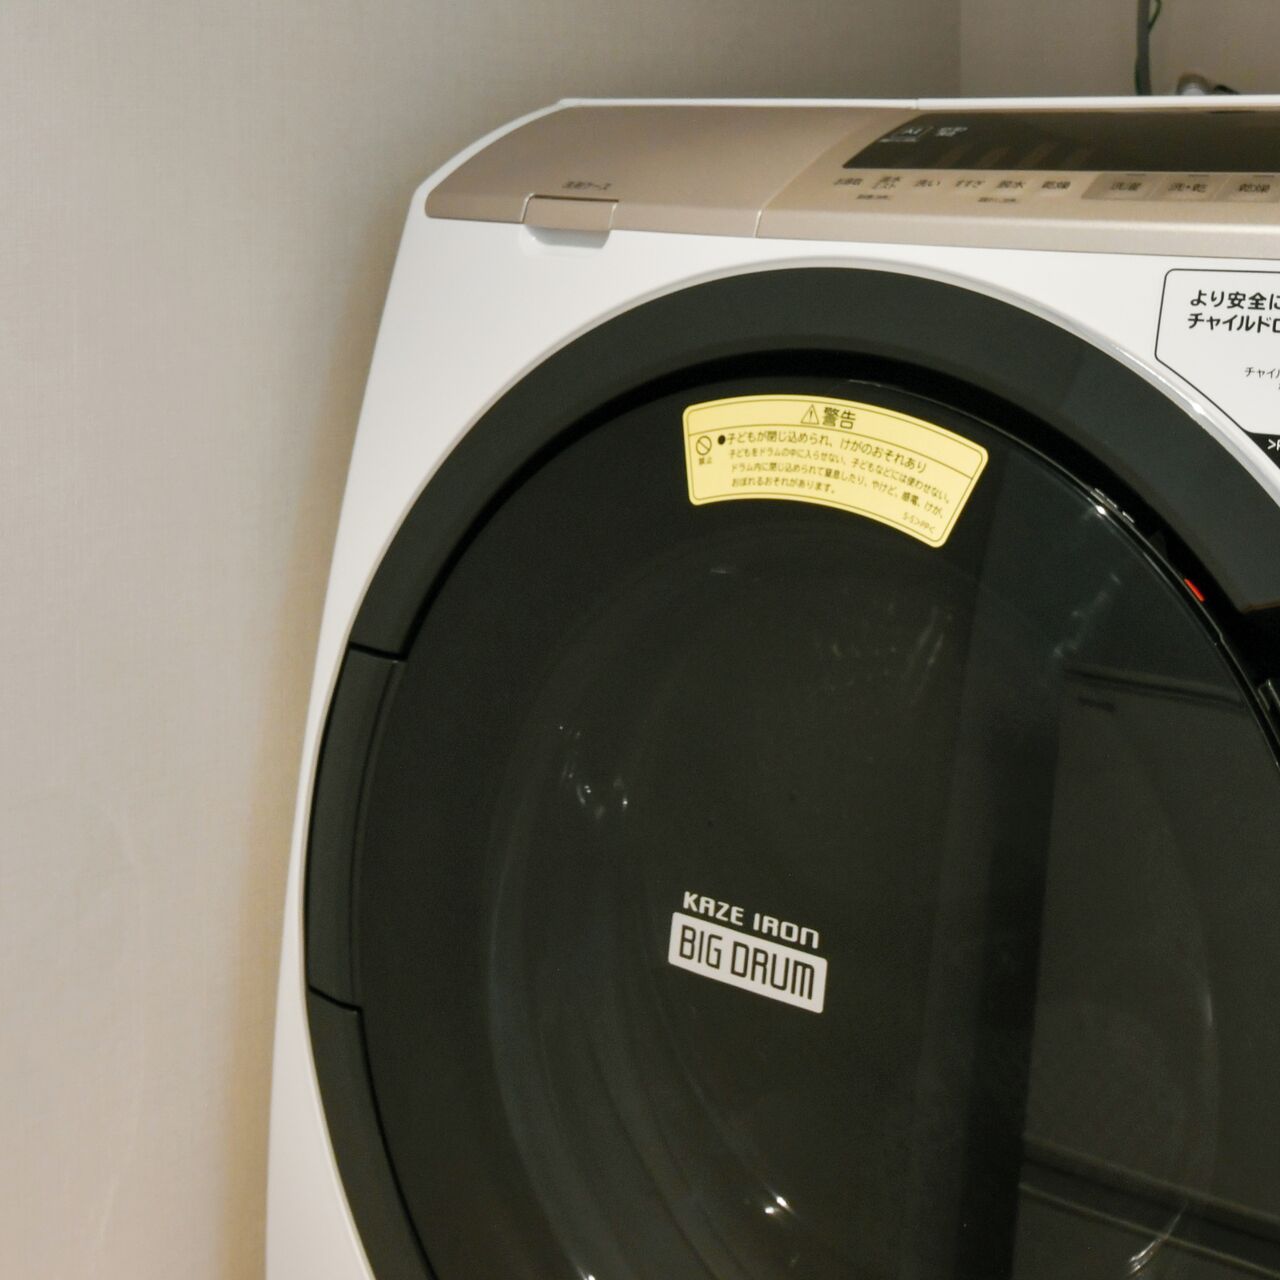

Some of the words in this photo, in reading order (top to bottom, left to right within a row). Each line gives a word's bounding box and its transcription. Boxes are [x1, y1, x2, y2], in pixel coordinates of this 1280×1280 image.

[821, 405, 857, 430] 警告
[682, 890, 745, 927] KAZE
[752, 912, 820, 950] IRON
[679, 924, 723, 970] BIG
[730, 940, 815, 1001] DRUM
